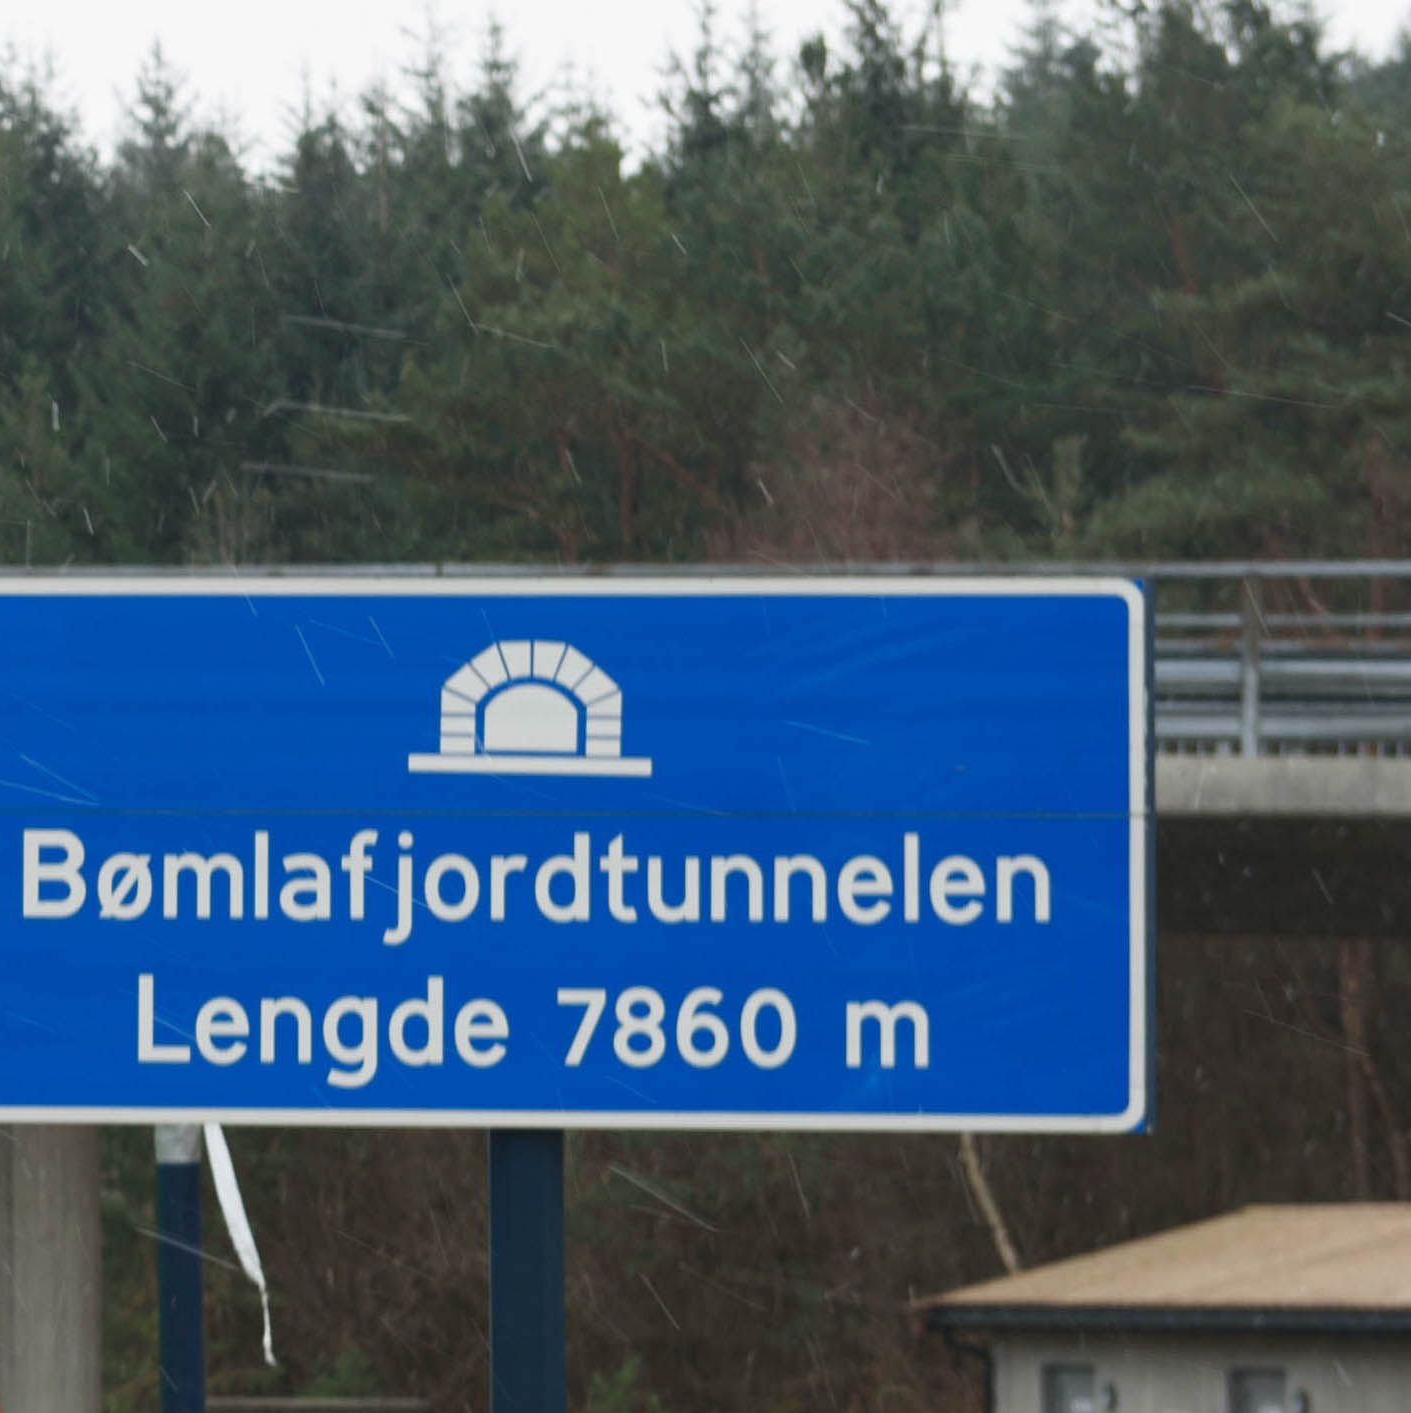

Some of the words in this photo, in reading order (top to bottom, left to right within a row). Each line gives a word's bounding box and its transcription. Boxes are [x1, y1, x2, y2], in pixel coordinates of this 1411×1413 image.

[21, 829, 1051, 946] Bømlafjordtunnelen
[136, 974, 510, 1088] Lengde
[557, 987, 798, 1068] 7860
[846, 1001, 930, 1068] m
